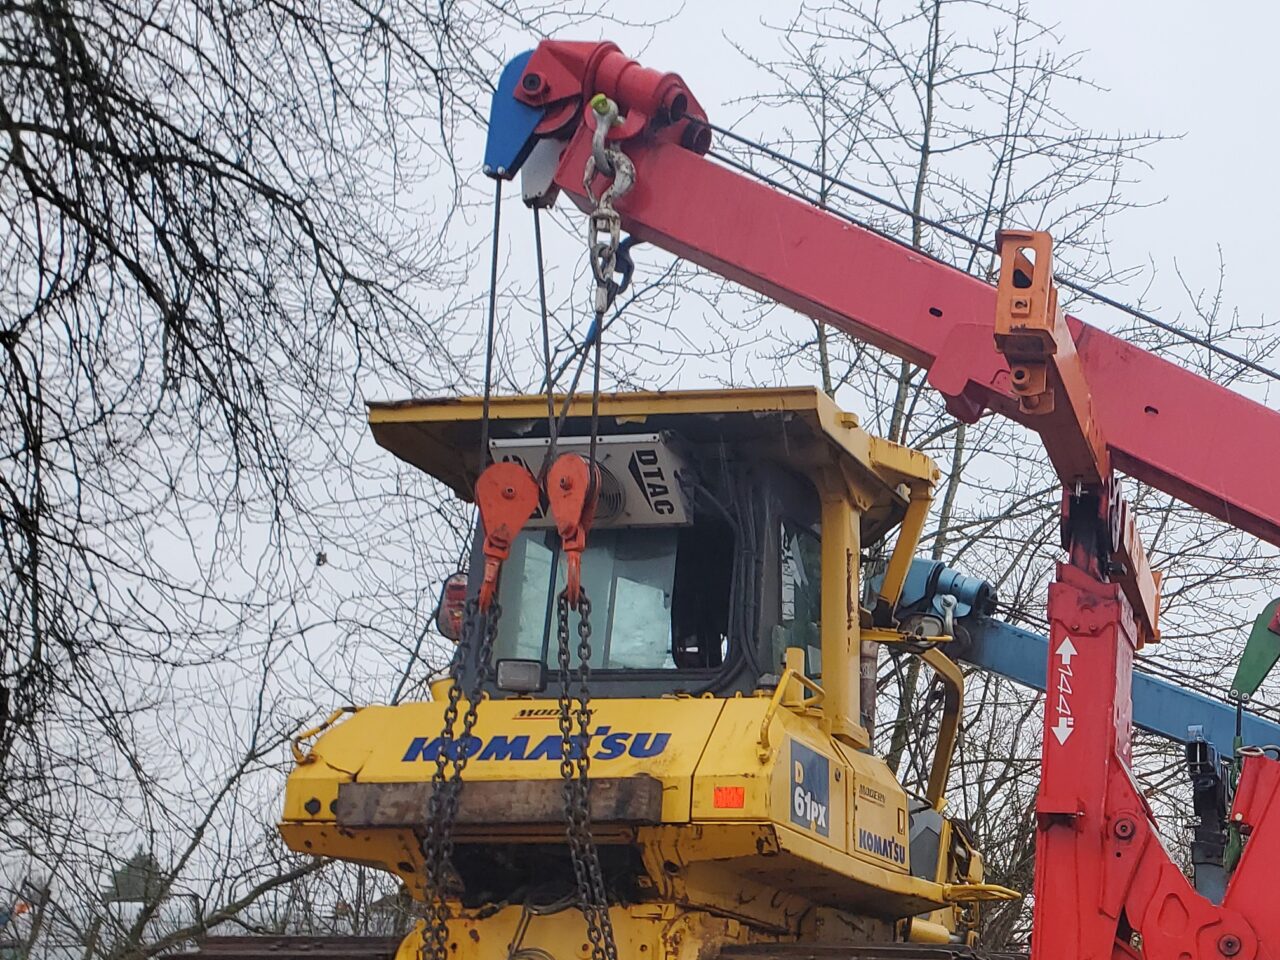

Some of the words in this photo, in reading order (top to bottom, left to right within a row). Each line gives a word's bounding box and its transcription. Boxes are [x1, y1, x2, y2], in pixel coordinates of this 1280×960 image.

[635, 449, 675, 516] DTAC
[794, 760, 804, 784] D
[859, 827, 905, 865] KOMATSU
